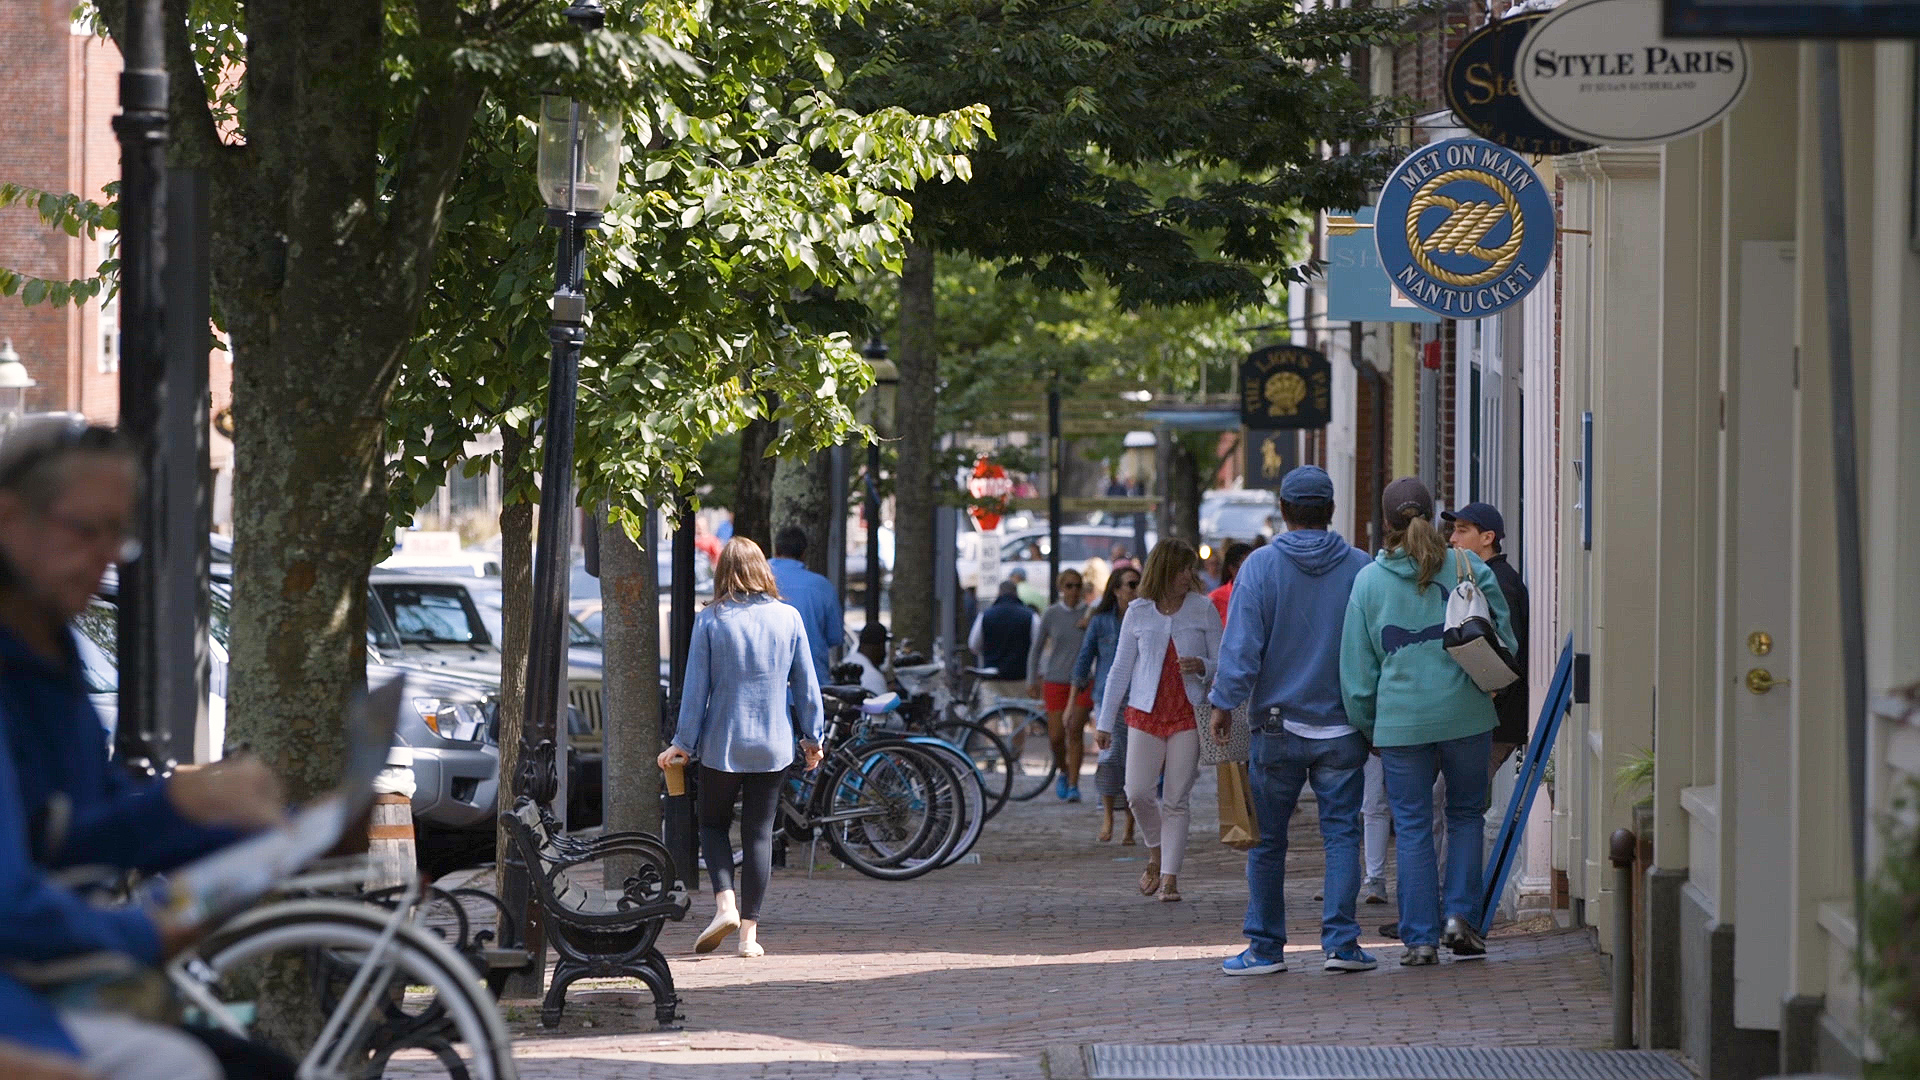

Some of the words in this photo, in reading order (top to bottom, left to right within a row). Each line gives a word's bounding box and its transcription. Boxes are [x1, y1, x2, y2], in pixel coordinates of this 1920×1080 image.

[1535, 49, 1634, 78] STYLE
[1644, 47, 1734, 75] PARIS
[1400, 151, 1443, 192] MET
[1446, 145, 1477, 166] ON
[1480, 147, 1535, 193] MAIN
[1396, 262, 1535, 313] NANTUCKET
